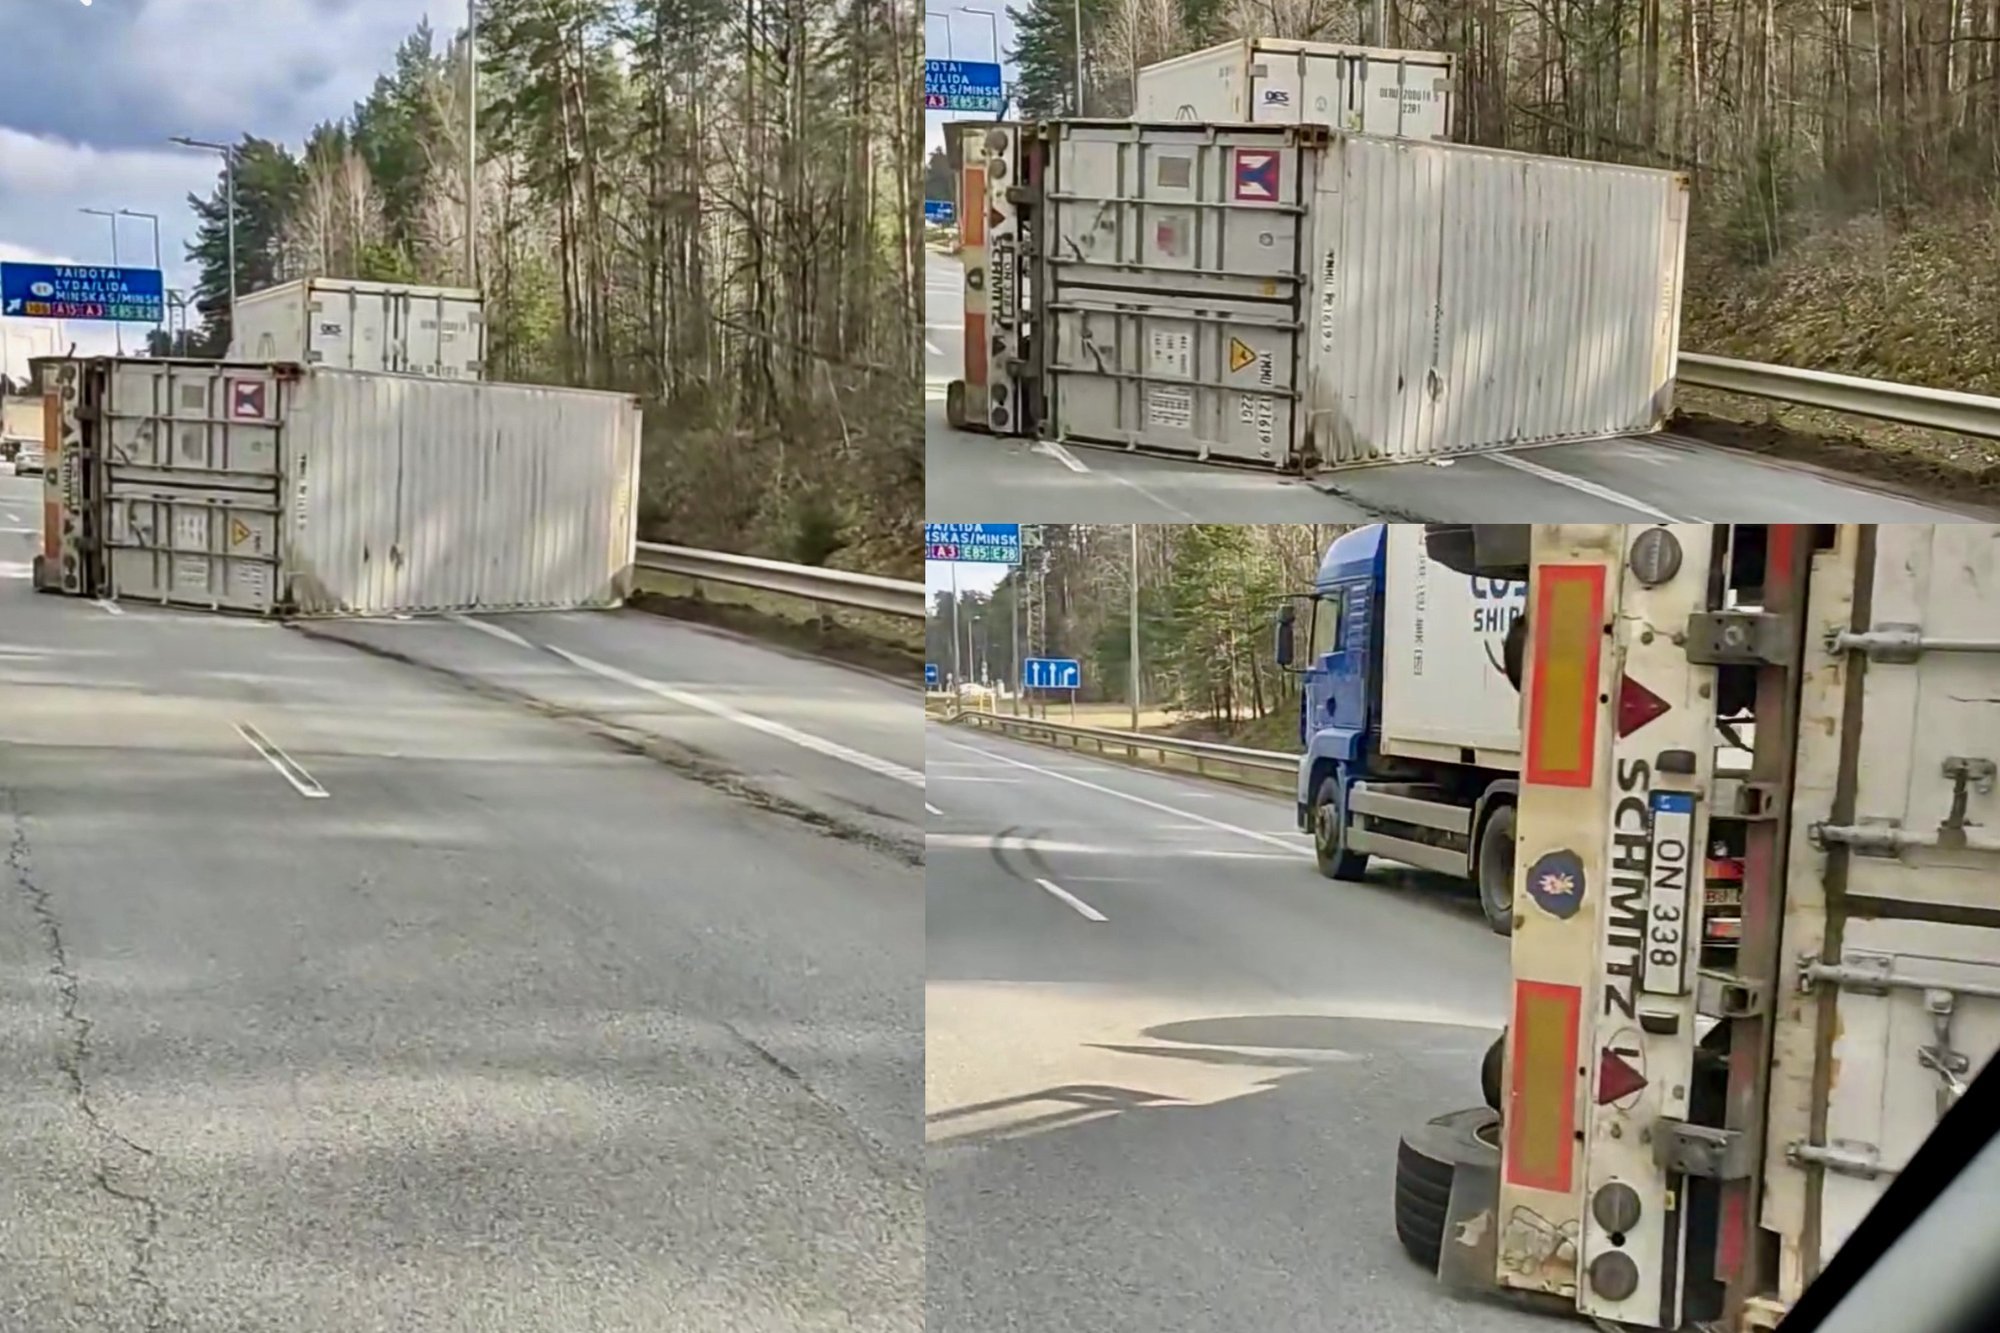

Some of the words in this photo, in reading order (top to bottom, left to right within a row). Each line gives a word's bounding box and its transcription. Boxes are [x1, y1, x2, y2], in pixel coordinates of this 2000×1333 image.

[55, 267, 121, 279] VAIDOTAI
[55, 280, 128, 292] LYDA/LIDA
[1604, 758, 1649, 1020] SCHMITZ
[1654, 839, 1685, 890] ON
[1650, 904, 1680, 967] 338
